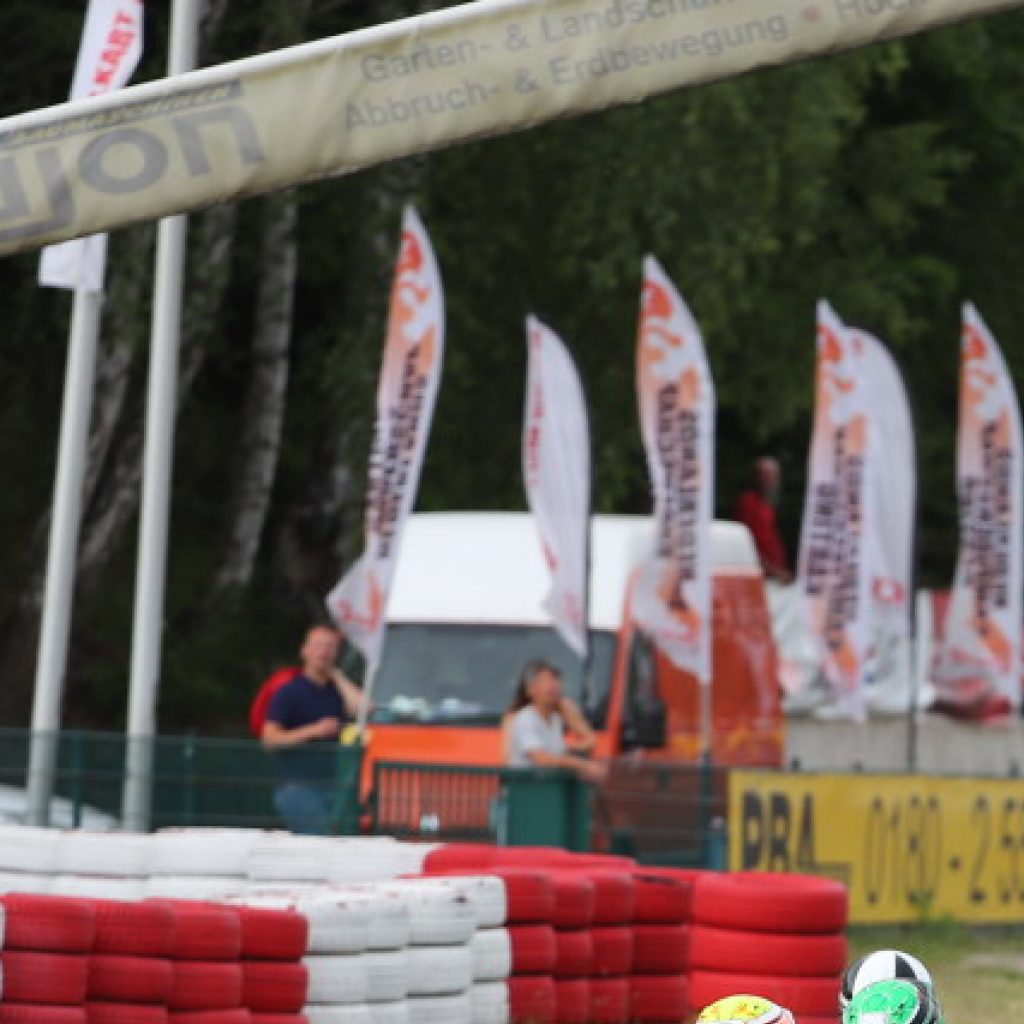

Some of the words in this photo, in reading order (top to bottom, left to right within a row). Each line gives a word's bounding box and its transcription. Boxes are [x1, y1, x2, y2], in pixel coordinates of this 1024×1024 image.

[345, 79, 501, 131] Abbruch-
[514, 69, 540, 95] &
[550, 12, 788, 85] Erdbewegung
[361, 38, 490, 83] Garten-
[505, 24, 532, 51] &
